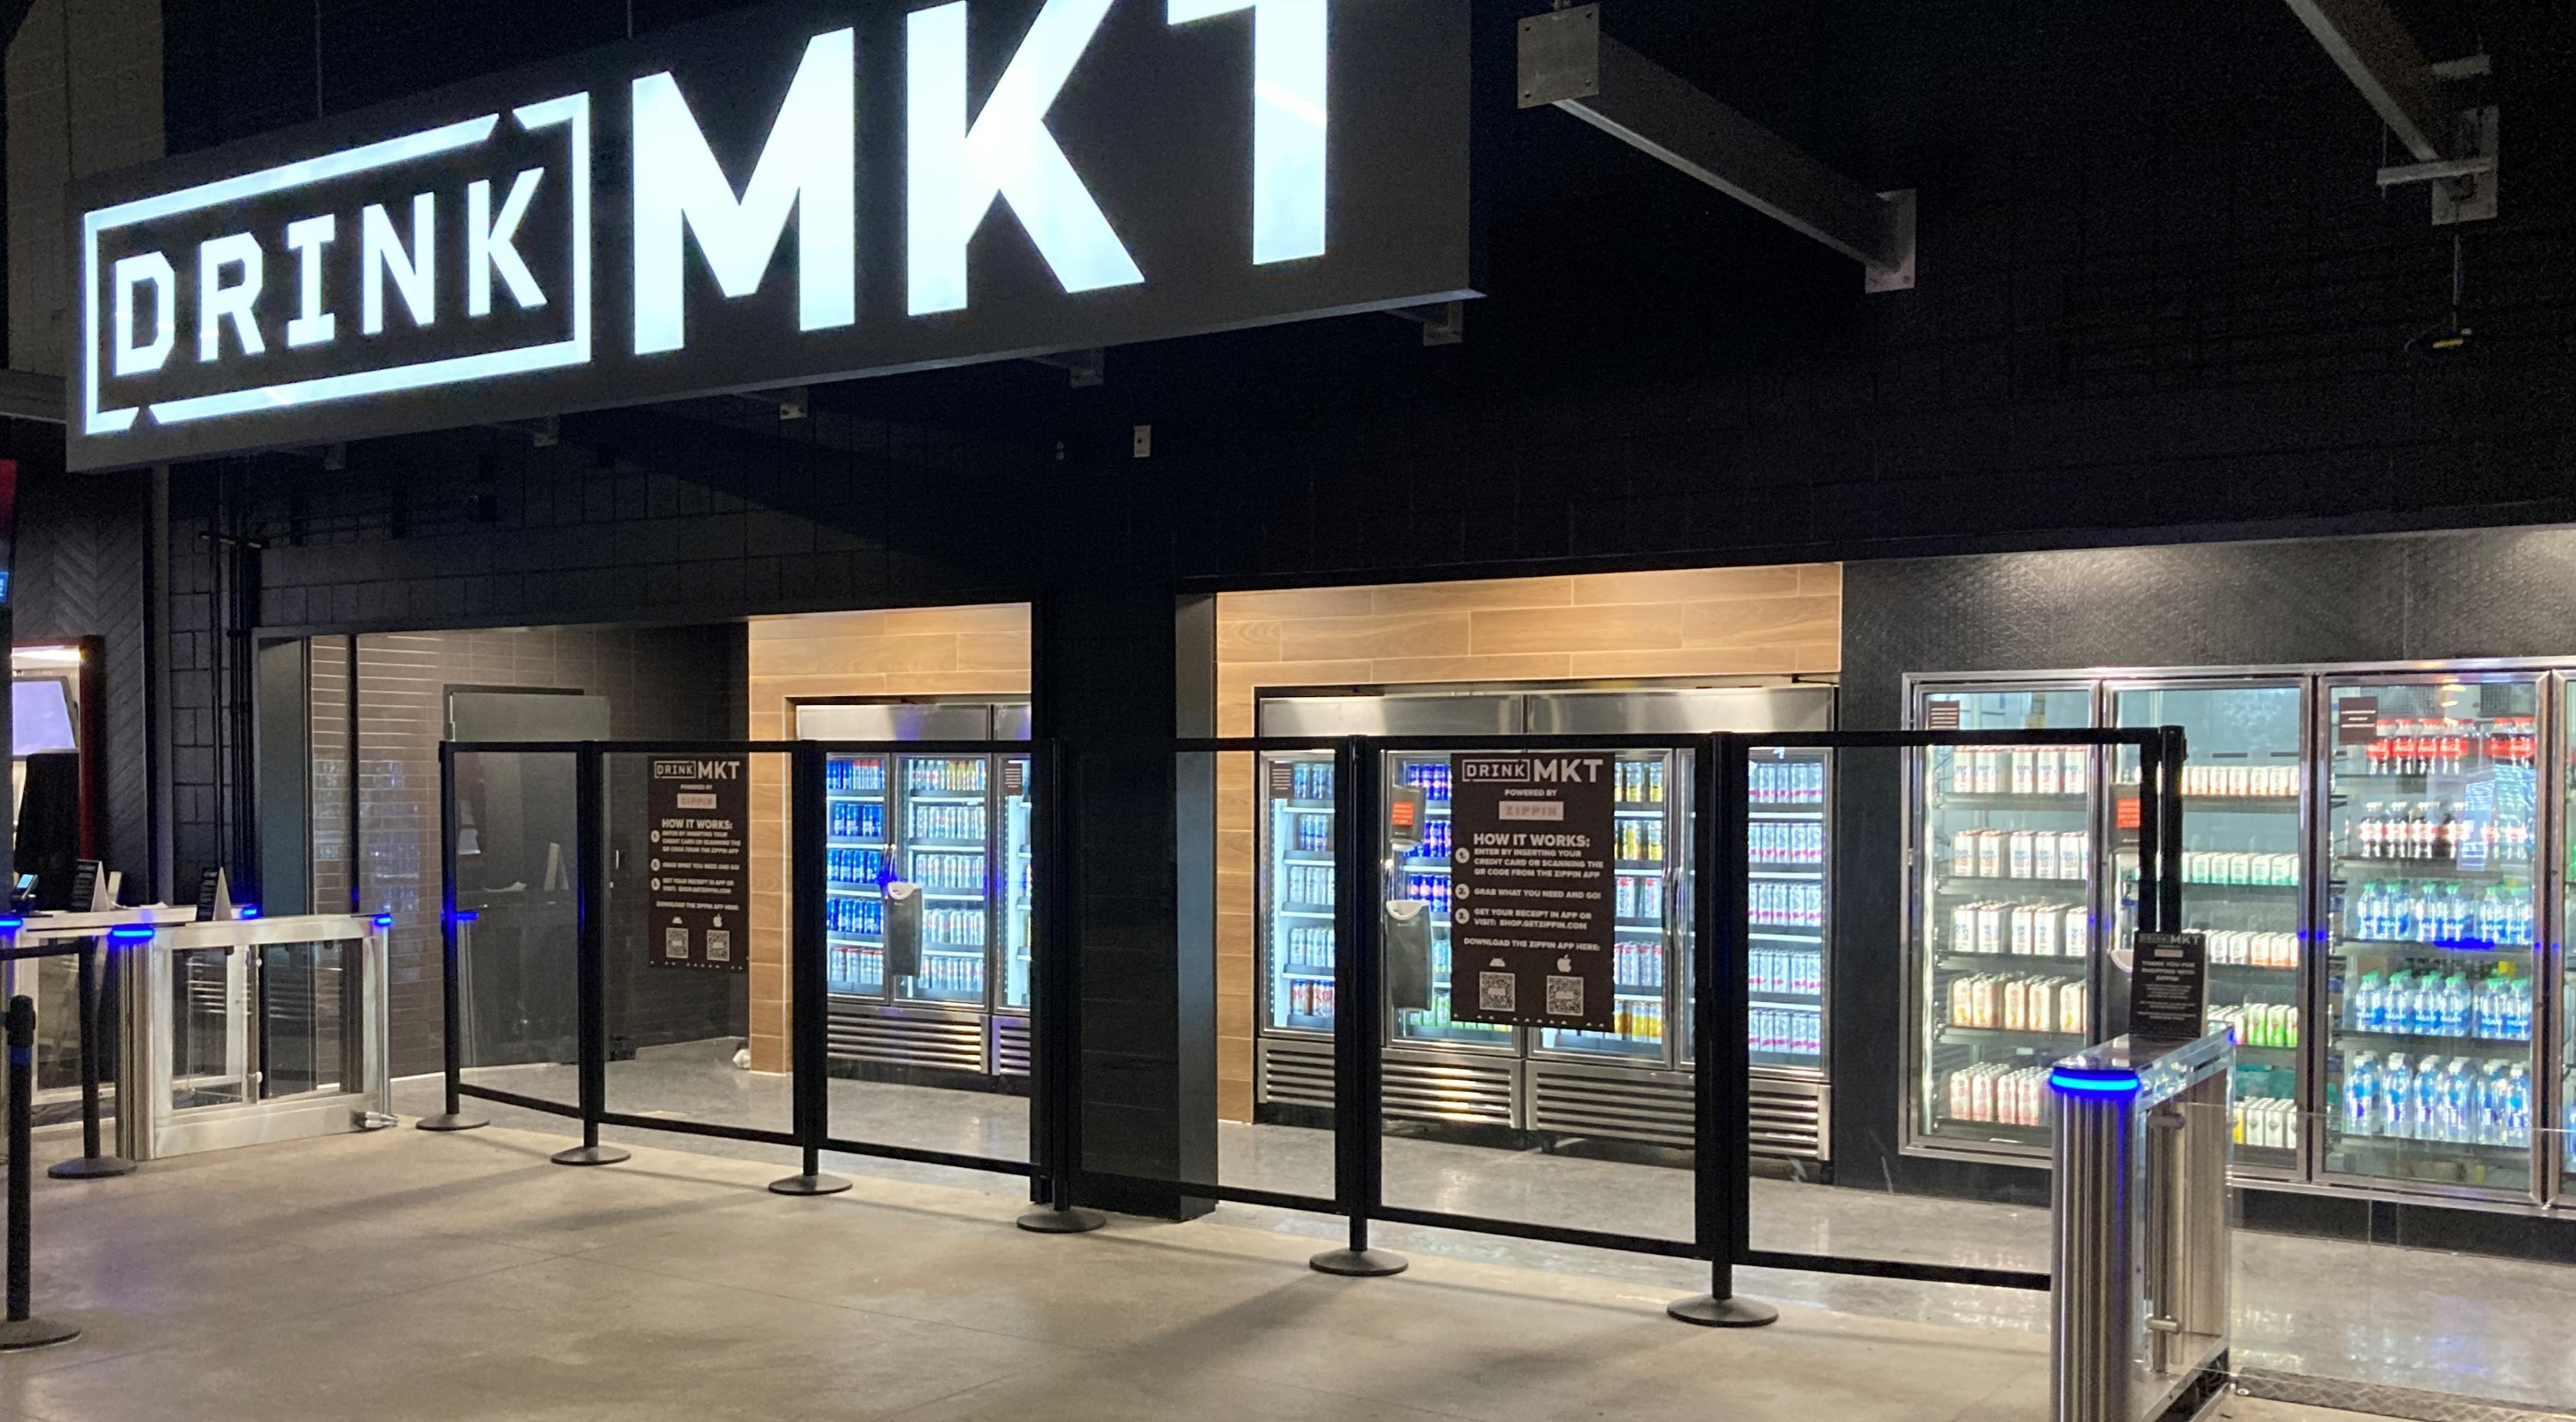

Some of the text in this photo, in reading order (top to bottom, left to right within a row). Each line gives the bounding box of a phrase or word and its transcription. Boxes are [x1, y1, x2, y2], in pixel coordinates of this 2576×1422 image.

[114, 0, 1326, 376] DRINK MKT
[658, 761, 740, 779] DRINK MKT
[1467, 758, 1603, 782] DRINK MKT
[1505, 806, 1557, 816] ZIPPIN
[662, 818, 733, 829] HOW IT WORKS:
[1474, 833, 1590, 848] HOW IT WORKS:
[1464, 937, 1510, 947] DOWNLOAD
[2171, 935, 2201, 944] MKT
